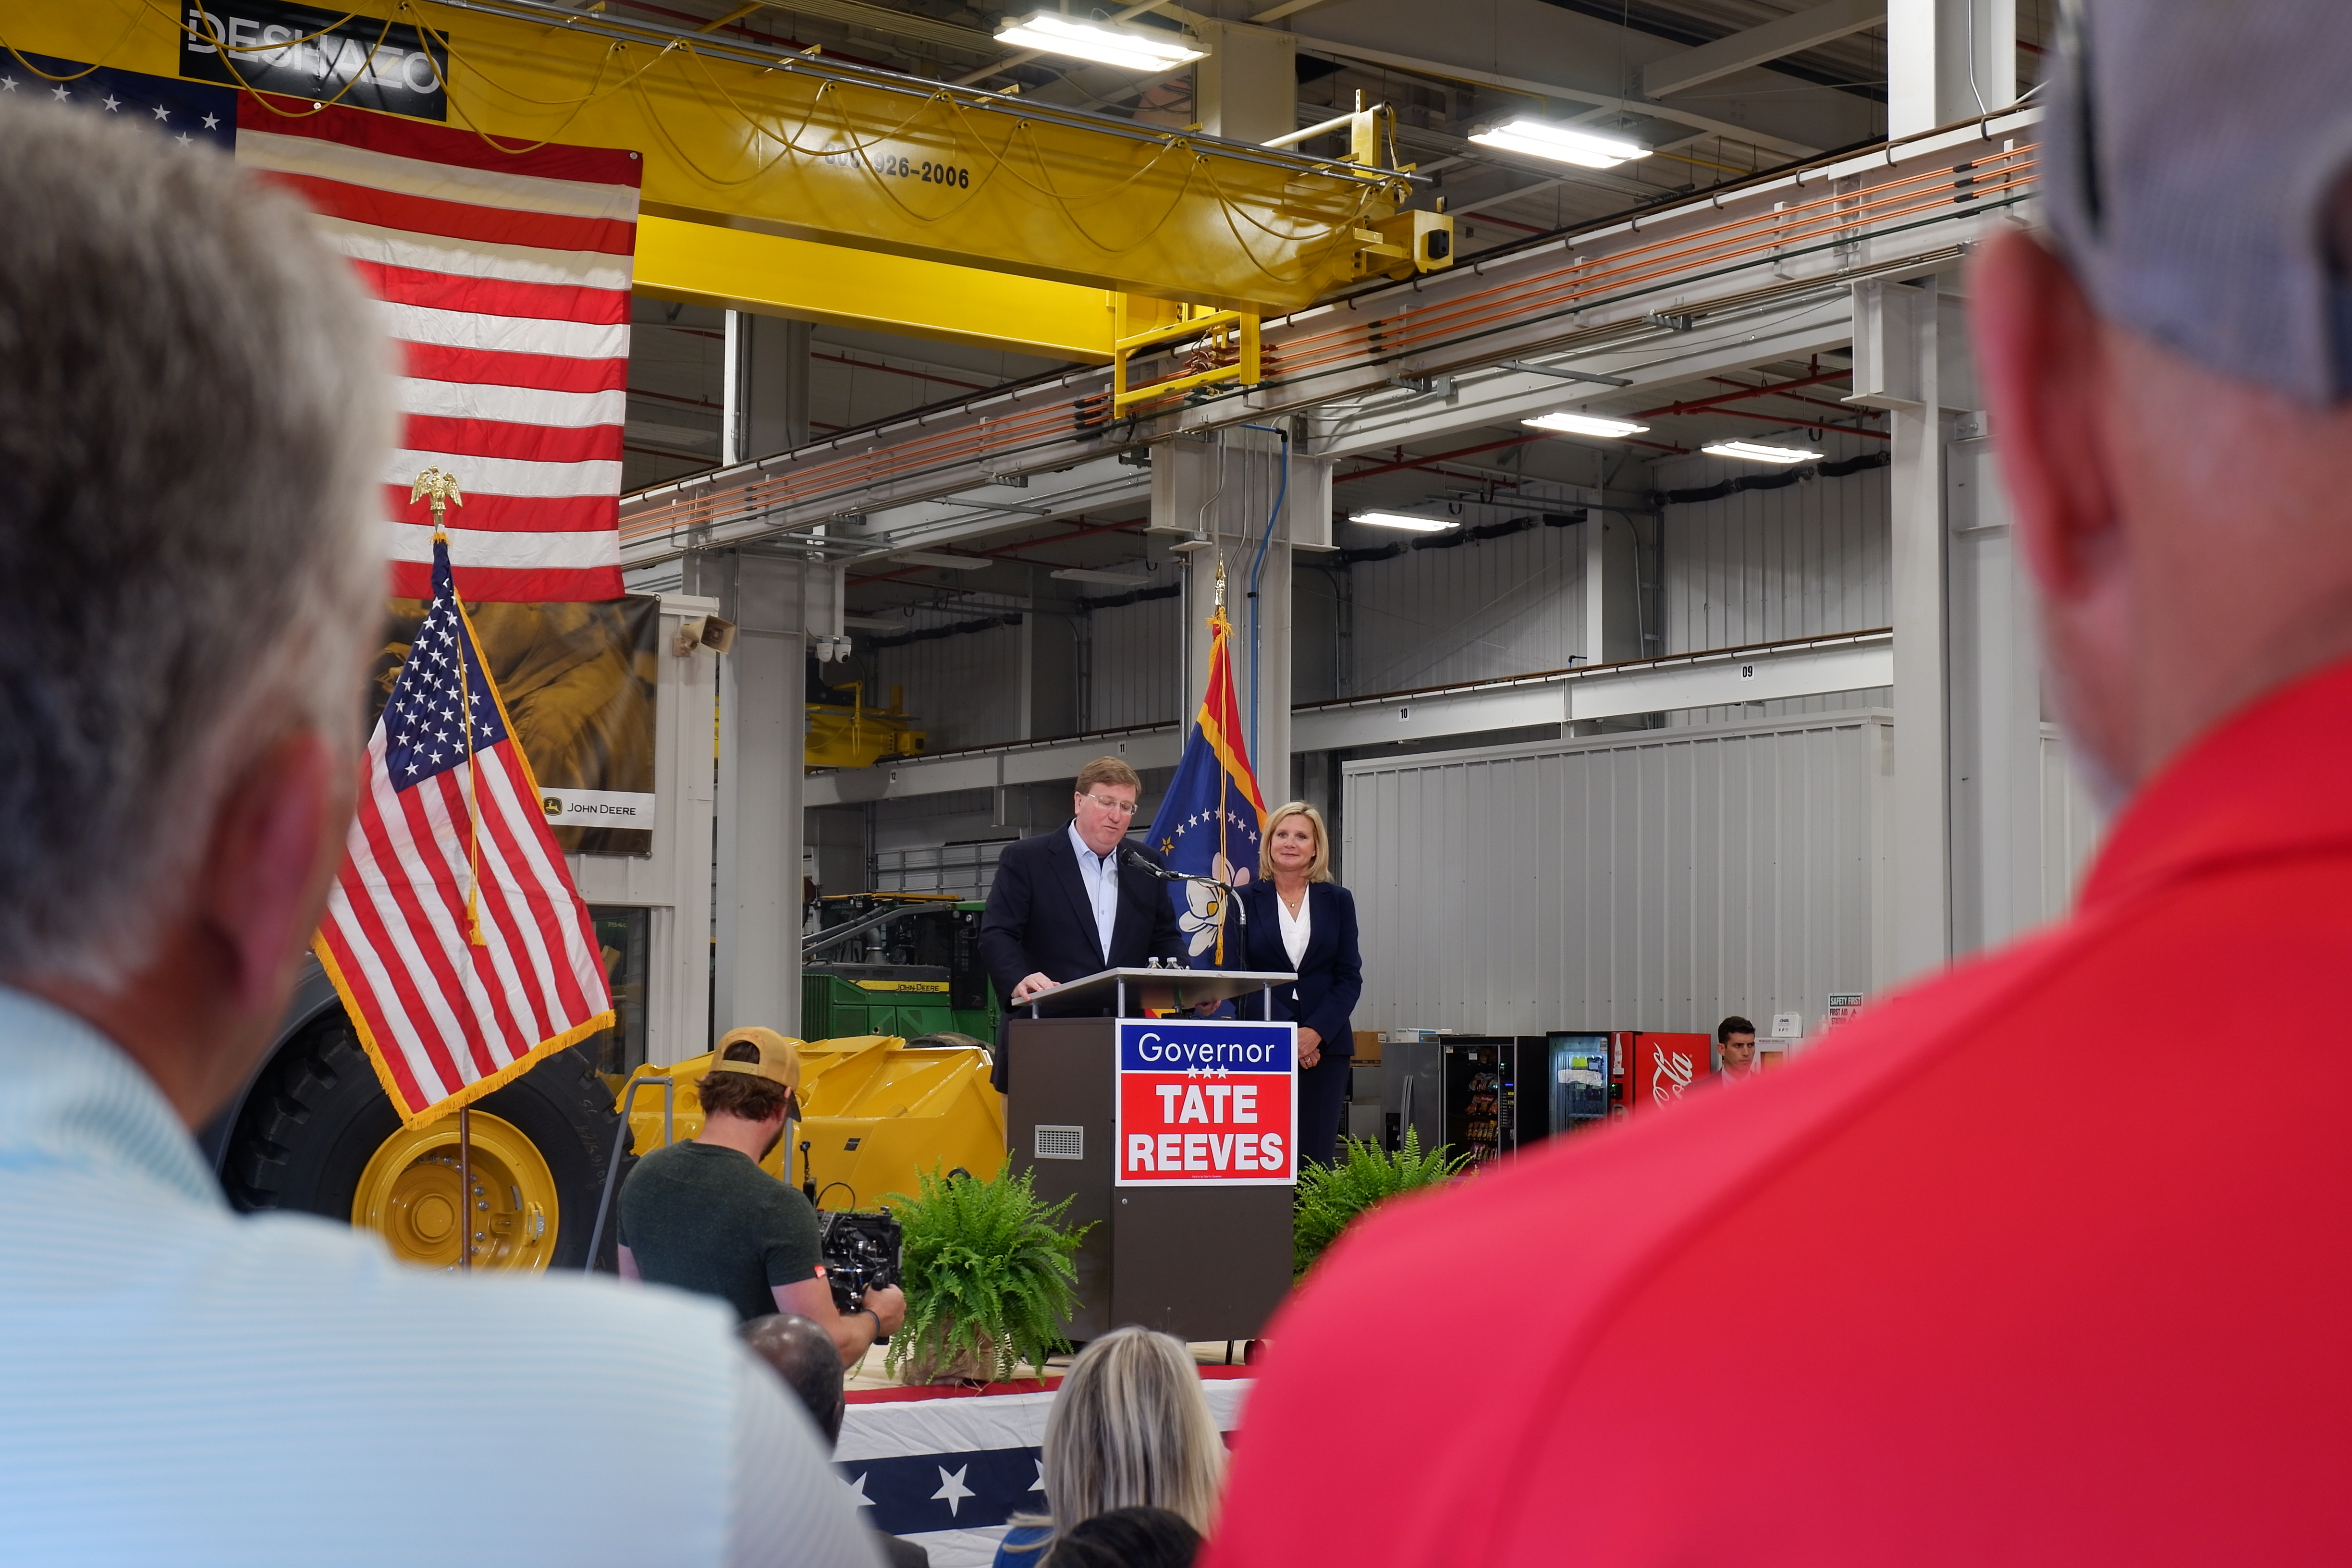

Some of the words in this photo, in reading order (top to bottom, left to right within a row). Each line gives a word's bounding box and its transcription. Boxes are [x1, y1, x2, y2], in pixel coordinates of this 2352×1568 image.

[188, 9, 441, 94] DESHAZO
[824, 143, 969, 189] 800-926-2006
[1742, 665, 1753, 678] 09
[1400, 708, 1408, 719] 10
[1120, 743, 1125, 753] 11
[891, 772, 896, 780] 12
[567, 802, 598, 813] JOHN
[600, 804, 637, 816] DEERE
[895, 983, 914, 991] JOHN
[916, 983, 939, 992] DEERE
[1830, 996, 1847, 1005] SAFETY
[1848, 996, 1861, 1005] FIRST
[1829, 1008, 1840, 1016] FIRST
[1139, 1032, 1275, 1063] Governor
[1155, 1084, 1258, 1124] TATE
[1128, 1132, 1284, 1171] REEVES
